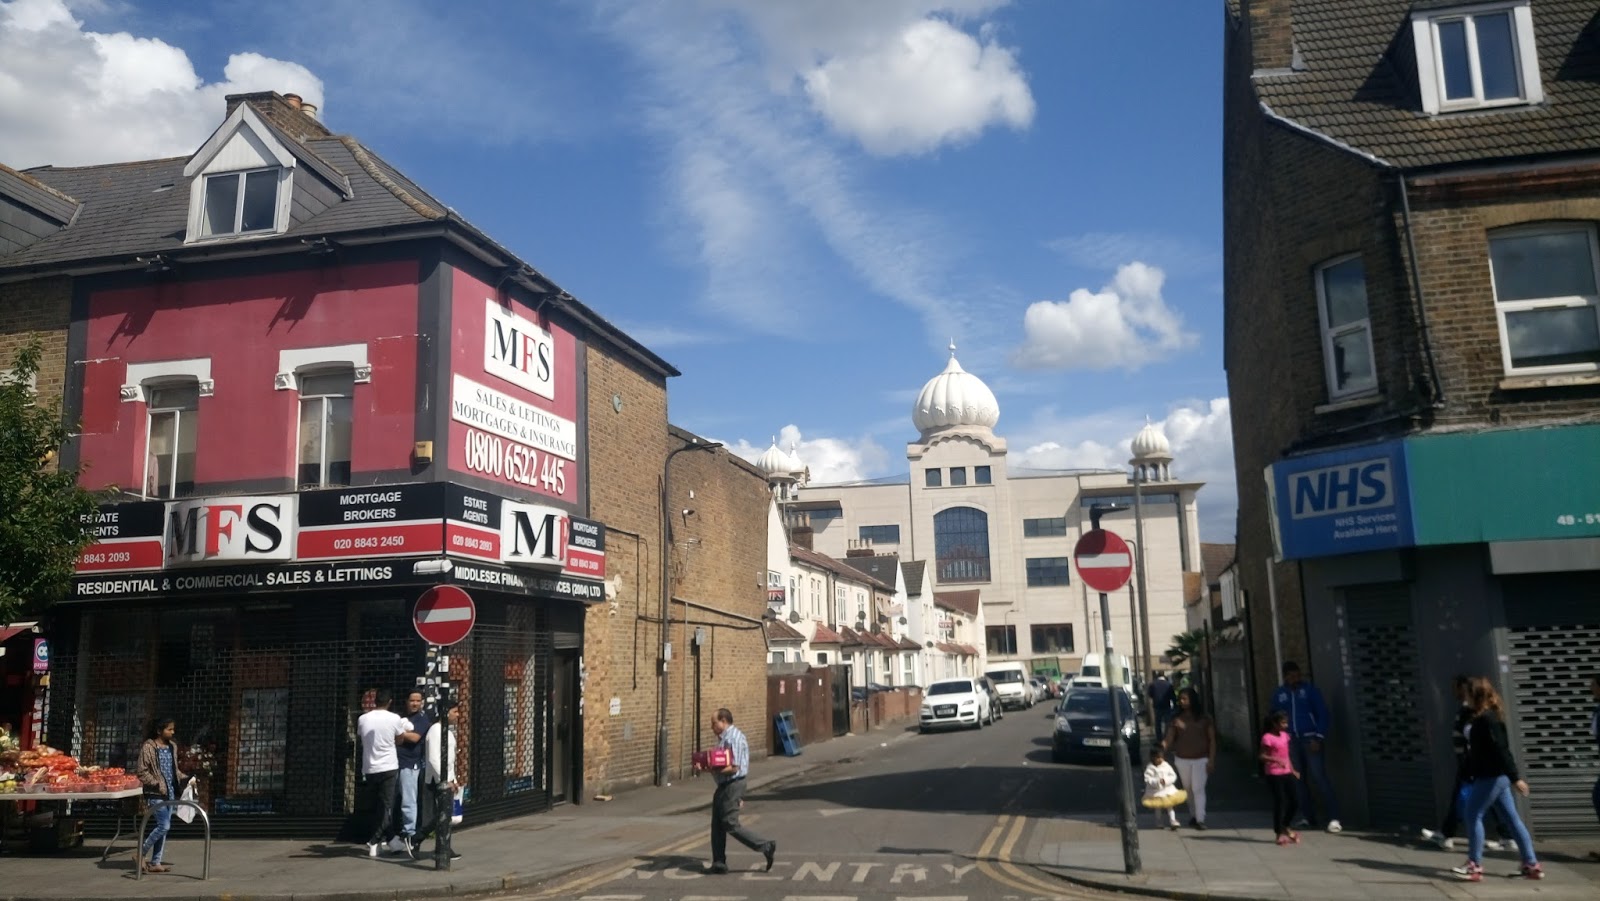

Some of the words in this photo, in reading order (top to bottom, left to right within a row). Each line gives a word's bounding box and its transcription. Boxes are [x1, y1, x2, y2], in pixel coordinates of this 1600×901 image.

[491, 317, 550, 382] MFS
[476, 388, 507, 412] SALES
[509, 402, 516, 416] &
[519, 406, 561, 433] LETTINGS
[454, 400, 518, 435] MORTGAGES
[520, 426, 527, 439] &
[529, 428, 576, 457] INSURANCE
[465, 428, 503, 476] 0800
[504, 442, 538, 487] 6522
[540, 454, 566, 495] 445
[1295, 463, 1386, 514] NHS
[340, 491, 402, 505] MORTGAGE
[463, 496, 487, 511] ESTATE
[343, 508, 396, 521] BROKERS
[462, 509, 488, 524] AGENTS
[1335, 516, 1355, 527] NHS
[1356, 512, 1396, 525] Services
[168, 503, 282, 558] MFS
[573, 521, 598, 535] MORTGAGE
[1334, 527, 1374, 539] Available
[1375, 525, 1398, 534] Here
[334, 539, 352, 549] 020
[354, 537, 378, 548] 8843
[380, 535, 404, 547] 2450
[452, 534, 464, 546] 020
[575, 535, 597, 548] BROKERS
[83, 554, 105, 564] 8843
[108, 552, 130, 563] 2093
[77, 579, 158, 595] RESIDENTIAL
[161, 579, 171, 590] &
[175, 573, 263, 590] COMMERCIAL
[266, 571, 311, 585] SALES
[314, 570, 325, 582] &
[328, 566, 392, 582] LETTINGS
[454, 566, 500, 585] MIDDLESEX
[501, 573, 538, 589] FINANCIAL
[540, 579, 571, 594] SERVICES
[572, 582, 589, 598] (2004)
[590, 586, 601, 597] LTD
[740, 861, 978, 884] ENTRY
